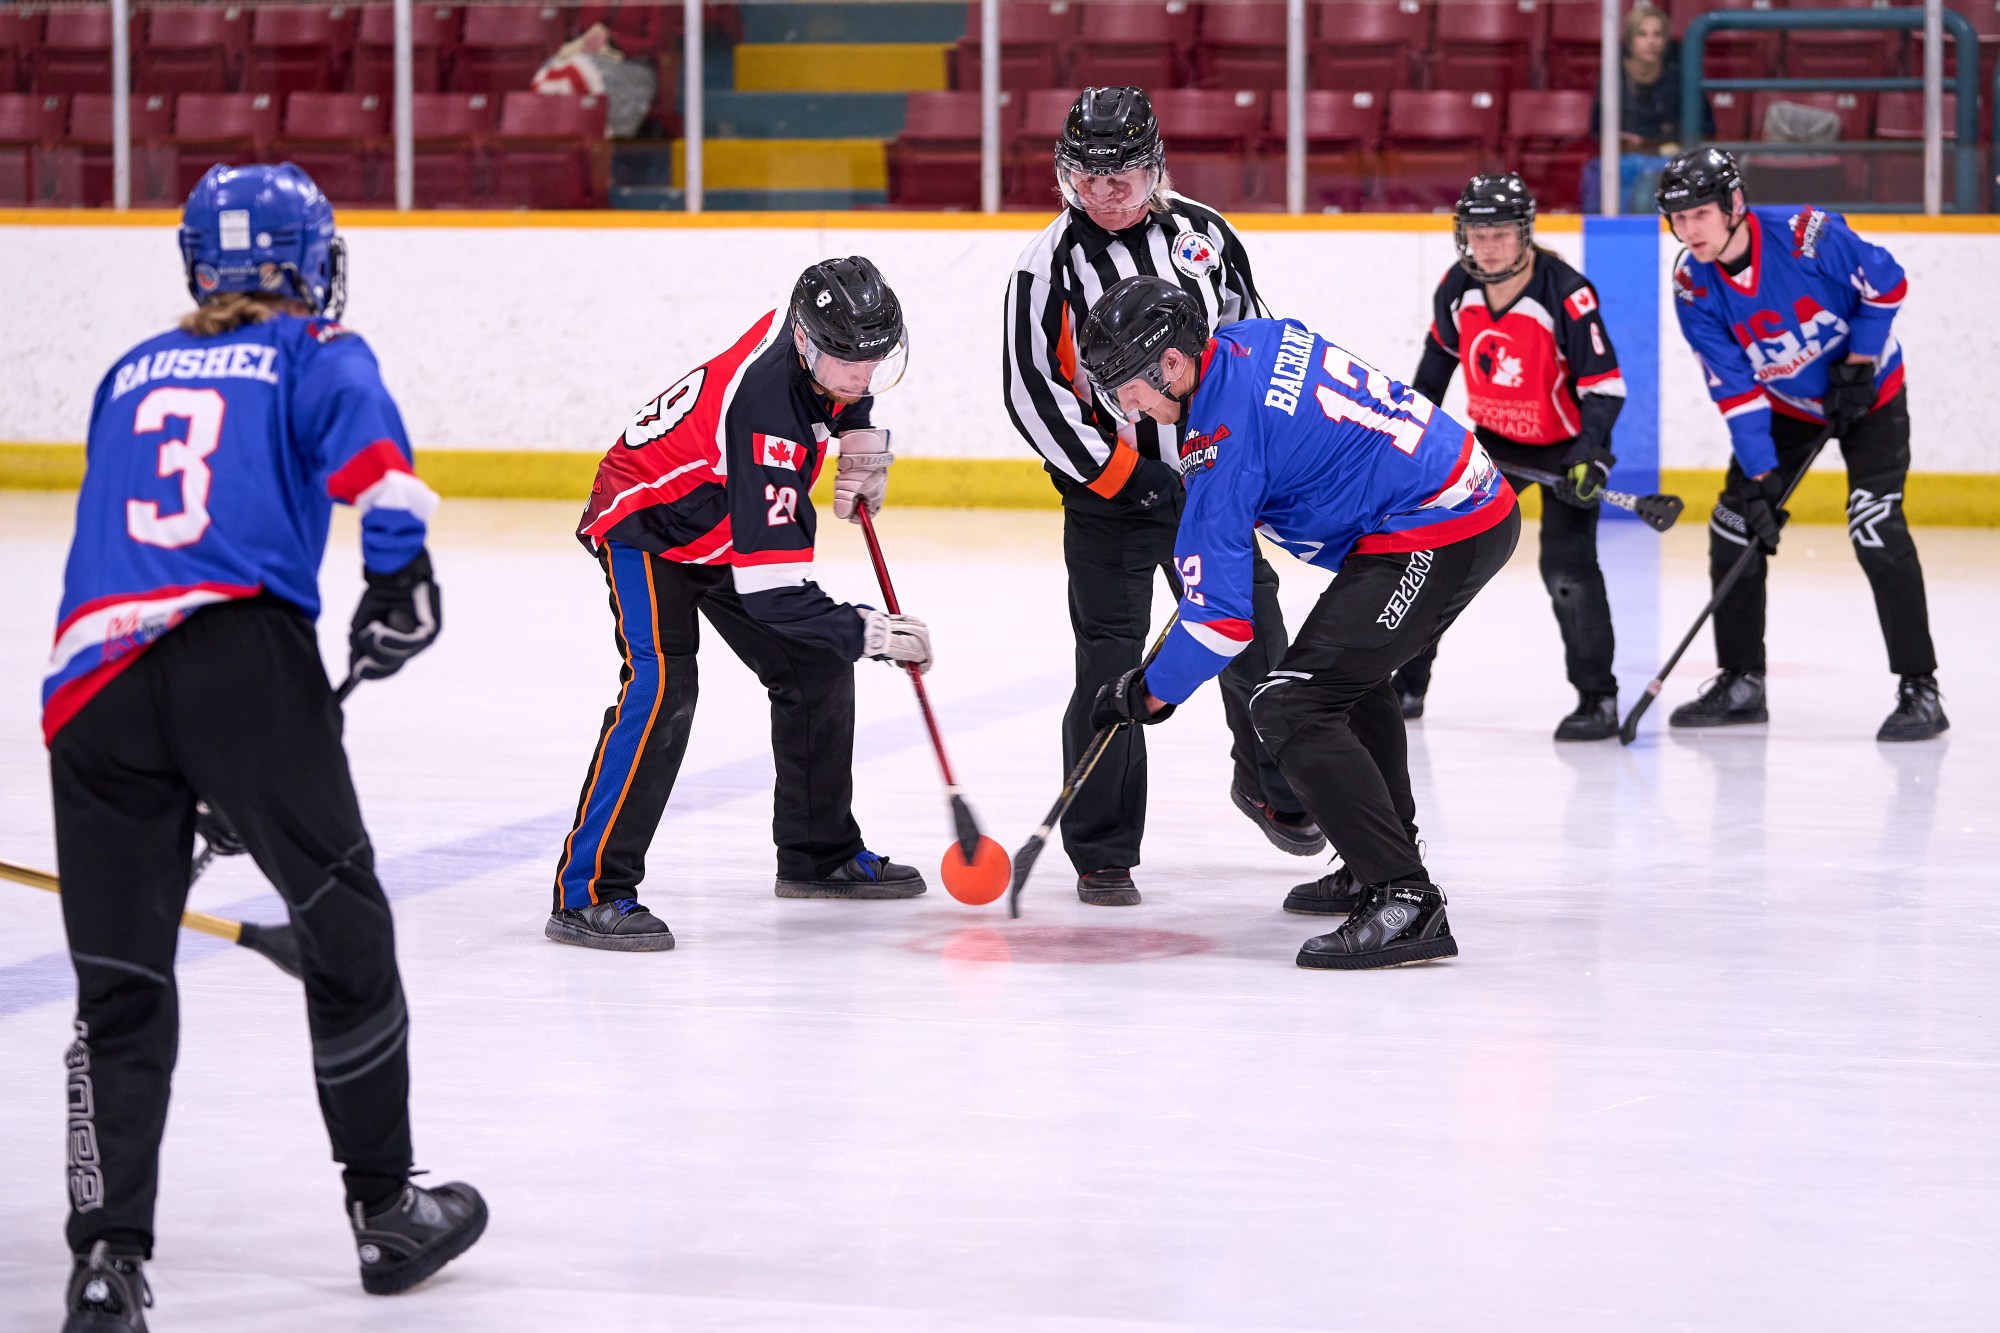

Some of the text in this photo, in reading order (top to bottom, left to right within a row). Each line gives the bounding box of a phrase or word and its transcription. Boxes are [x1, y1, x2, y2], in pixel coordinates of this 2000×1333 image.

[816, 289, 832, 308] 8
[859, 336, 889, 348] CCM
[1144, 324, 1169, 348] CCM
[111, 343, 279, 402] RAUSHEL
[1314, 345, 1435, 457] 12
[126, 387, 226, 549] 3
[1376, 549, 1434, 630] APPER
